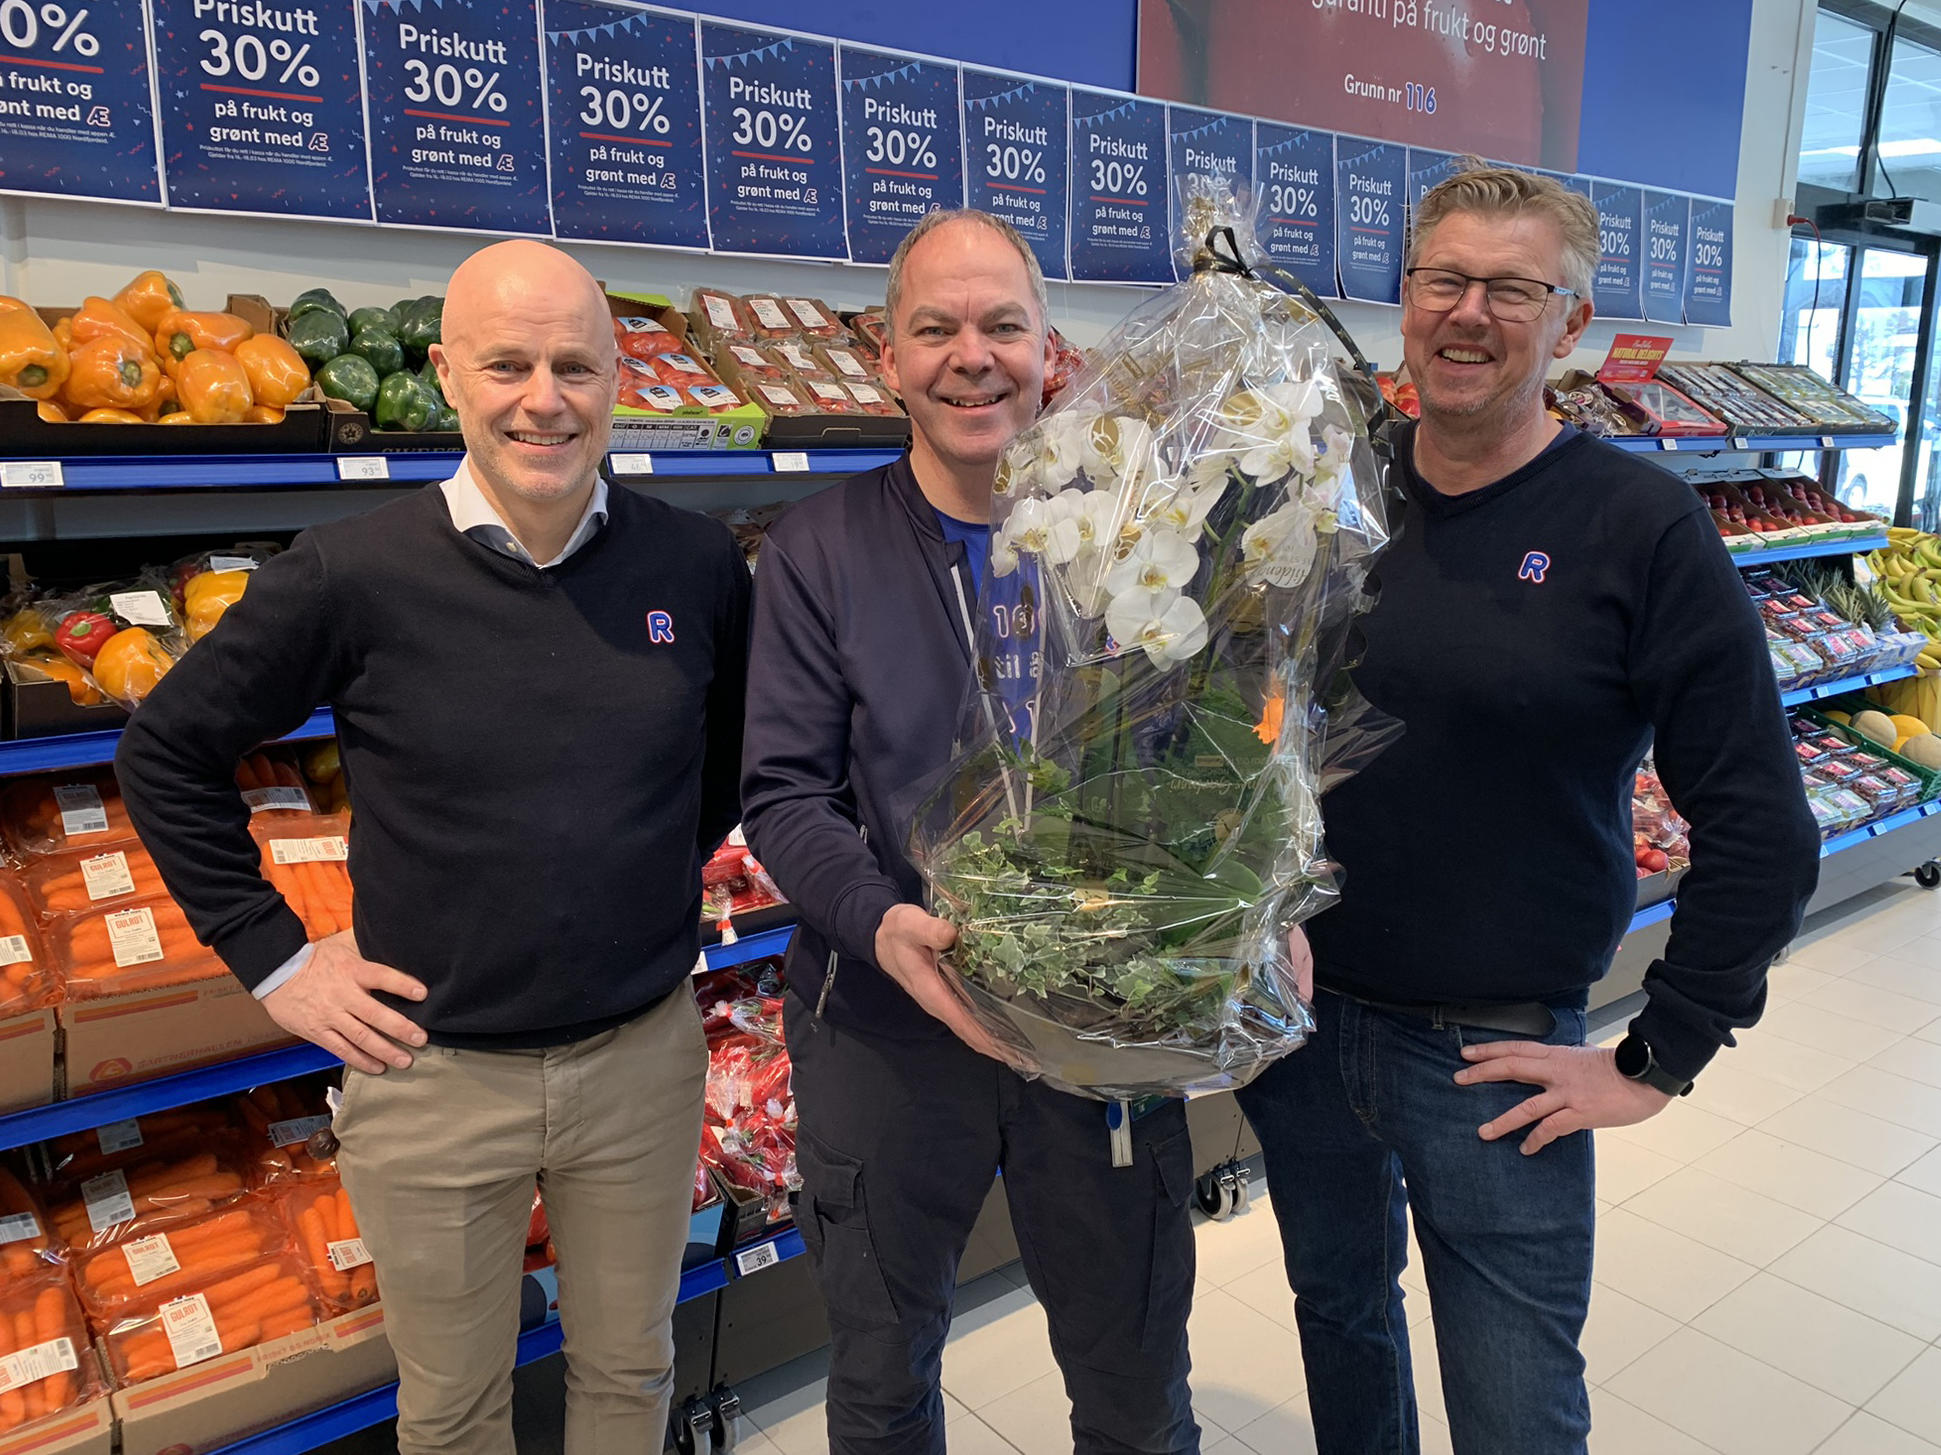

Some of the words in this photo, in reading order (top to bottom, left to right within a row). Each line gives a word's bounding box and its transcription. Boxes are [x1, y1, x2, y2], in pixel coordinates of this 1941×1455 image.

[0, 0, 99, 56] 0%
[194, 0, 319, 36] Priskutt
[1312, 0, 1386, 18] anti
[1393, 0, 1417, 28] på
[1424, 3, 1469, 40] frukt
[1473, 22, 1496, 52] og
[1500, 29, 1546, 60] grønt
[199, 29, 320, 87] 30%
[400, 23, 508, 65] Priskutt
[577, 53, 670, 89] Priskutt
[8, 72, 62, 94] frukt
[67, 83, 92, 100] og
[404, 59, 507, 112] 30%
[730, 77, 812, 110] Priskutt
[1344, 74, 1385, 100] Grunn
[1388, 88, 1402, 103] nr
[1405, 81, 1437, 115] 116
[0, 100, 31, 116] ønt
[36, 104, 80, 121] med
[86, 106, 111, 127] Æ
[215, 100, 237, 118] på
[242, 102, 287, 122] frukt
[291, 112, 313, 127] og
[580, 86, 670, 134] 30%
[865, 98, 937, 129] Priskutt
[210, 127, 260, 143] grønt
[265, 132, 303, 147] med
[308, 132, 329, 152] Æ
[416, 124, 436, 141] på
[439, 126, 479, 144] frukt
[482, 135, 501, 149] og
[733, 107, 812, 152] 30%
[985, 117, 1047, 146] Priskutt
[412, 149, 455, 164] grønt
[459, 153, 492, 167] med
[496, 154, 515, 172] Æ
[590, 145, 607, 161] på
[610, 147, 645, 164] frukt
[647, 155, 664, 168] og
[866, 127, 937, 168] 30%
[1090, 134, 1148, 160] Priskutt
[1186, 148, 1236, 174] Priskutt
[586, 169, 624, 182] grønt
[627, 172, 656, 185] med
[741, 163, 756, 178] på
[759, 165, 790, 180] frukt
[792, 171, 807, 184] og
[986, 144, 1045, 183] 30%
[1091, 159, 1147, 195] 30%
[1270, 162, 1318, 185] Priskutt
[737, 185, 771, 198] grønt
[774, 188, 800, 200] med
[873, 179, 886, 194] på
[889, 181, 916, 195] frukt
[918, 187, 932, 199] og
[1350, 174, 1392, 196] Priskutt
[869, 200, 900, 212] grønt
[902, 202, 925, 214] med
[993, 193, 1004, 206] på
[1005, 195, 1028, 209] frukt
[1029, 201, 1040, 212] og
[1095, 206, 1106, 219] på
[1108, 207, 1130, 220] frukt
[1132, 212, 1143, 223] og
[1270, 185, 1317, 217] 30%
[1350, 195, 1389, 226] 30%
[1016, 215, 1035, 227] med
[1092, 225, 1117, 235] grønt
[1119, 226, 1138, 236] med
[1518, 550, 1551, 584] R
[645, 610, 675, 644] R
